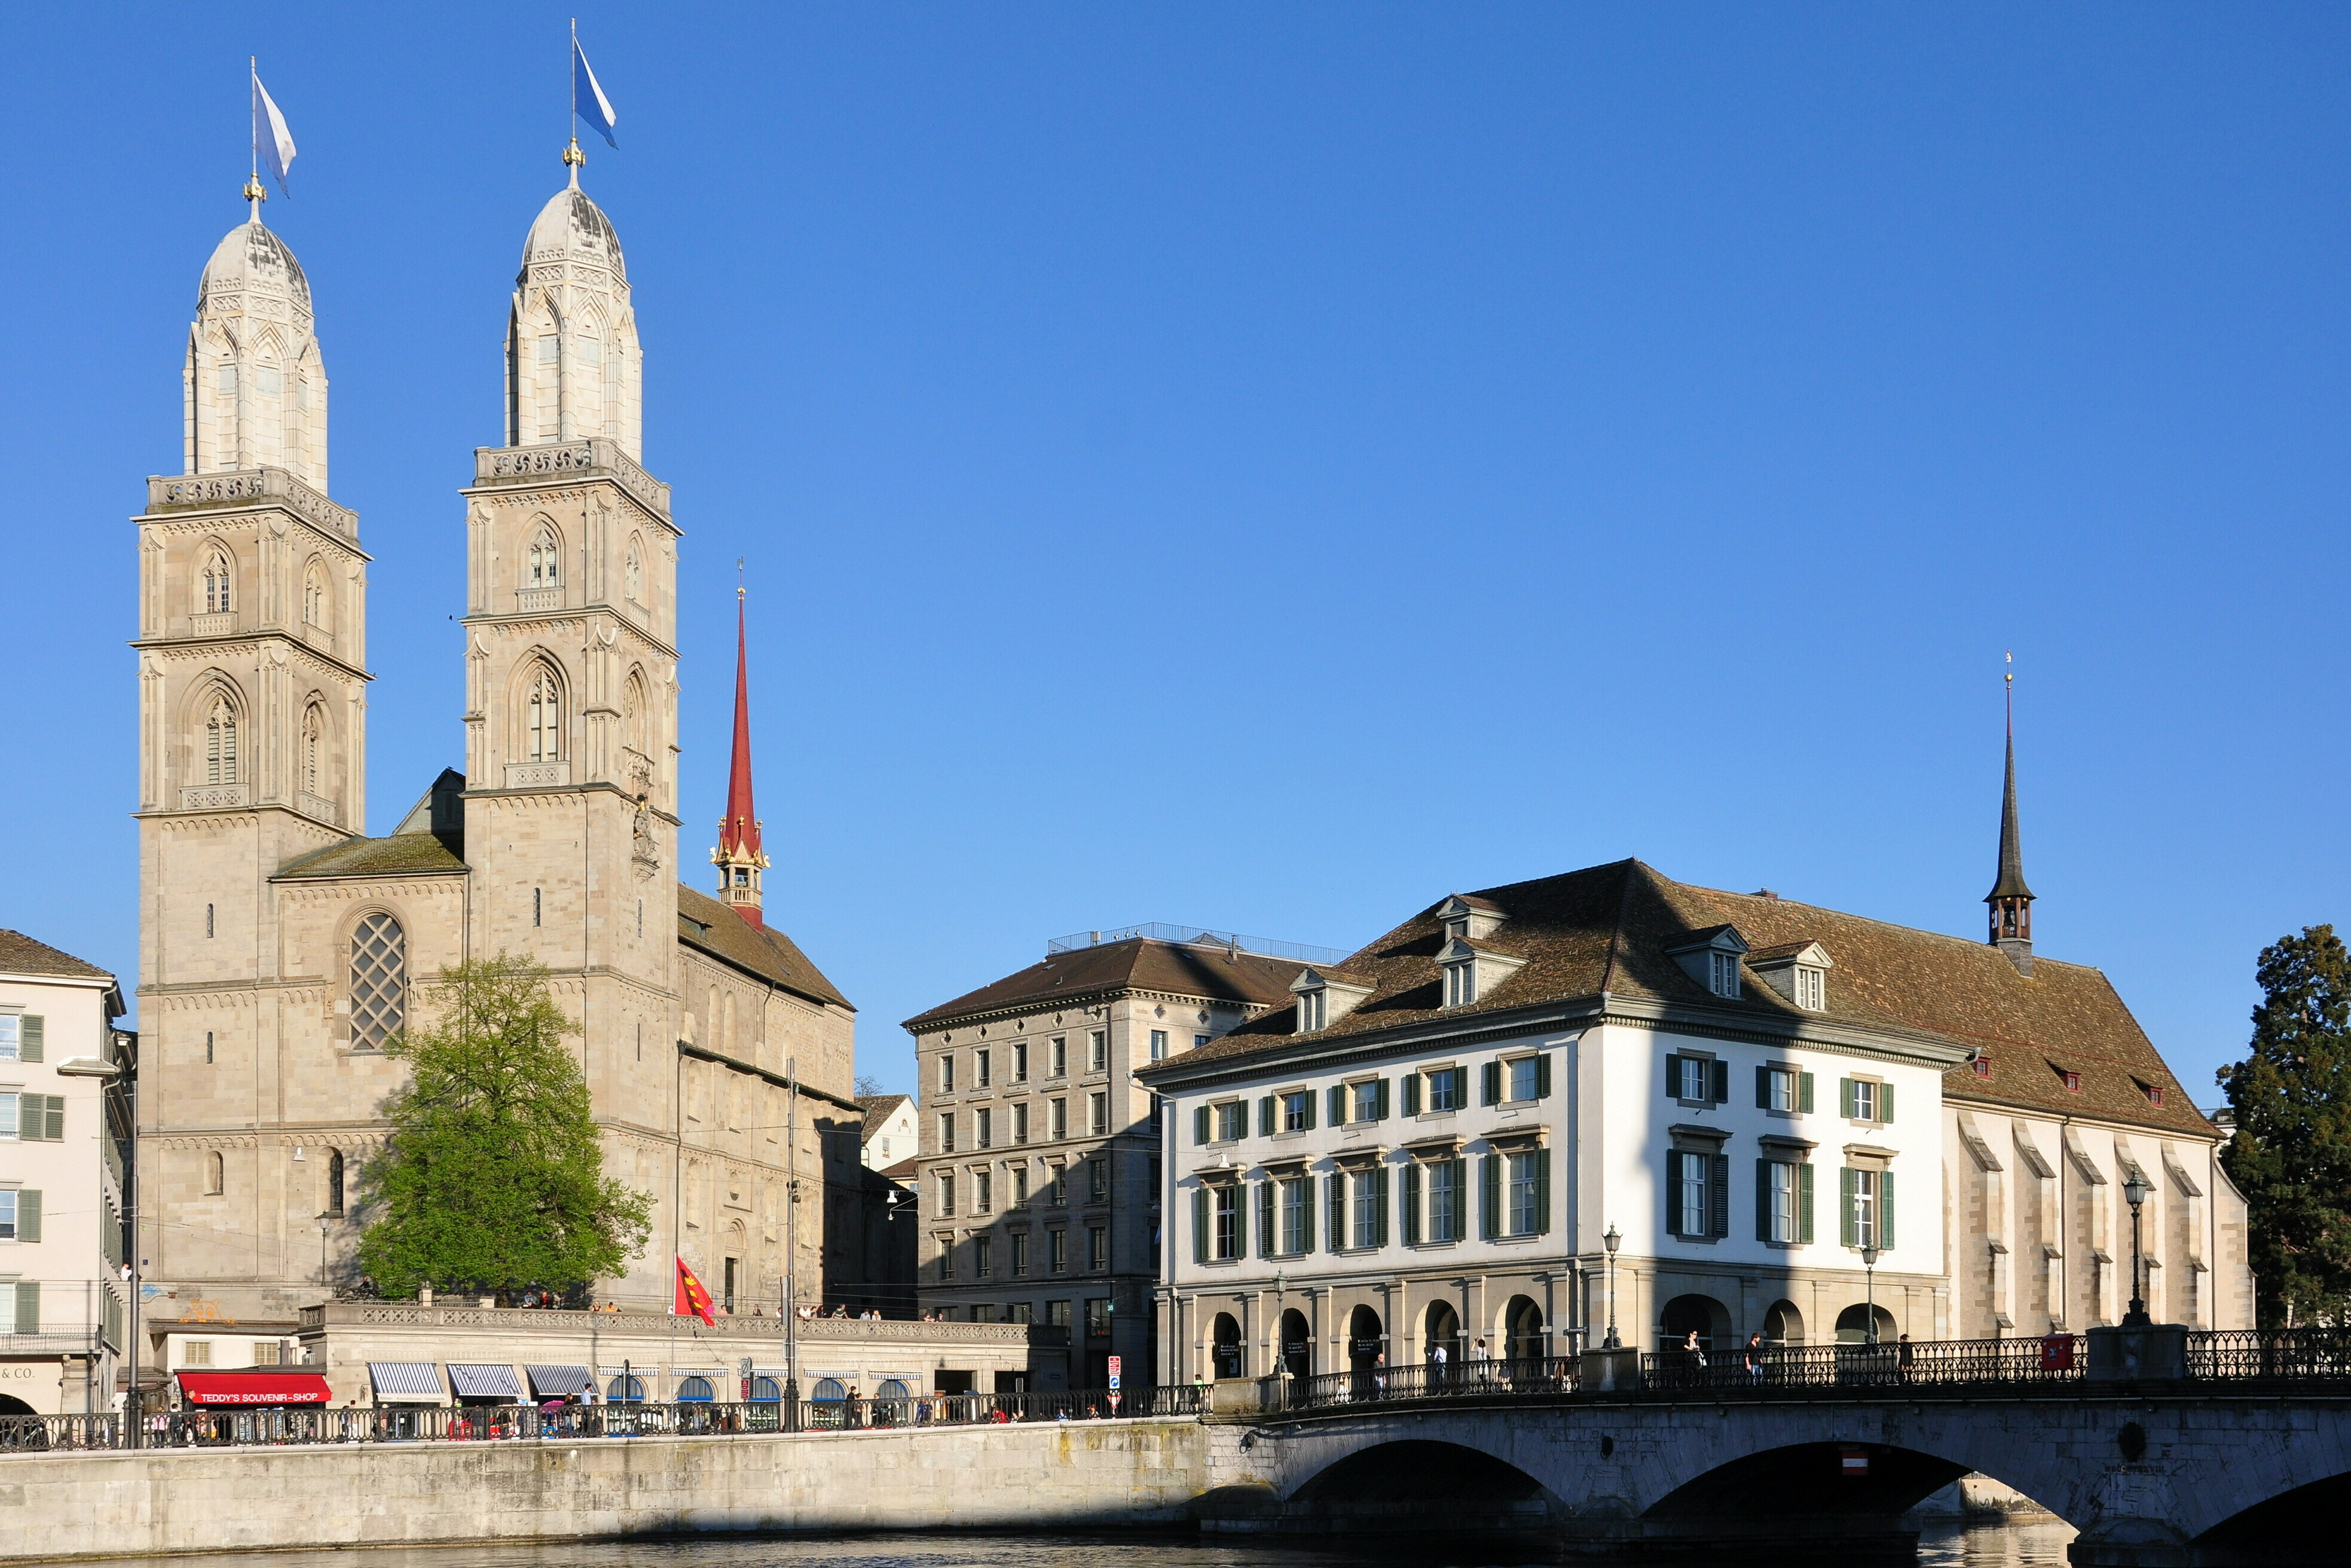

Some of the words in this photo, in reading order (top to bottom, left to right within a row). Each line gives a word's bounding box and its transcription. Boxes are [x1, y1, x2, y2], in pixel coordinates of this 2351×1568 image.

[2, 1368, 10, 1379] &
[14, 1368, 35, 1379] CO.
[201, 1394, 240, 1402] TEDDY'S
[241, 1393, 318, 1402] SOUVENIR-SHOP
